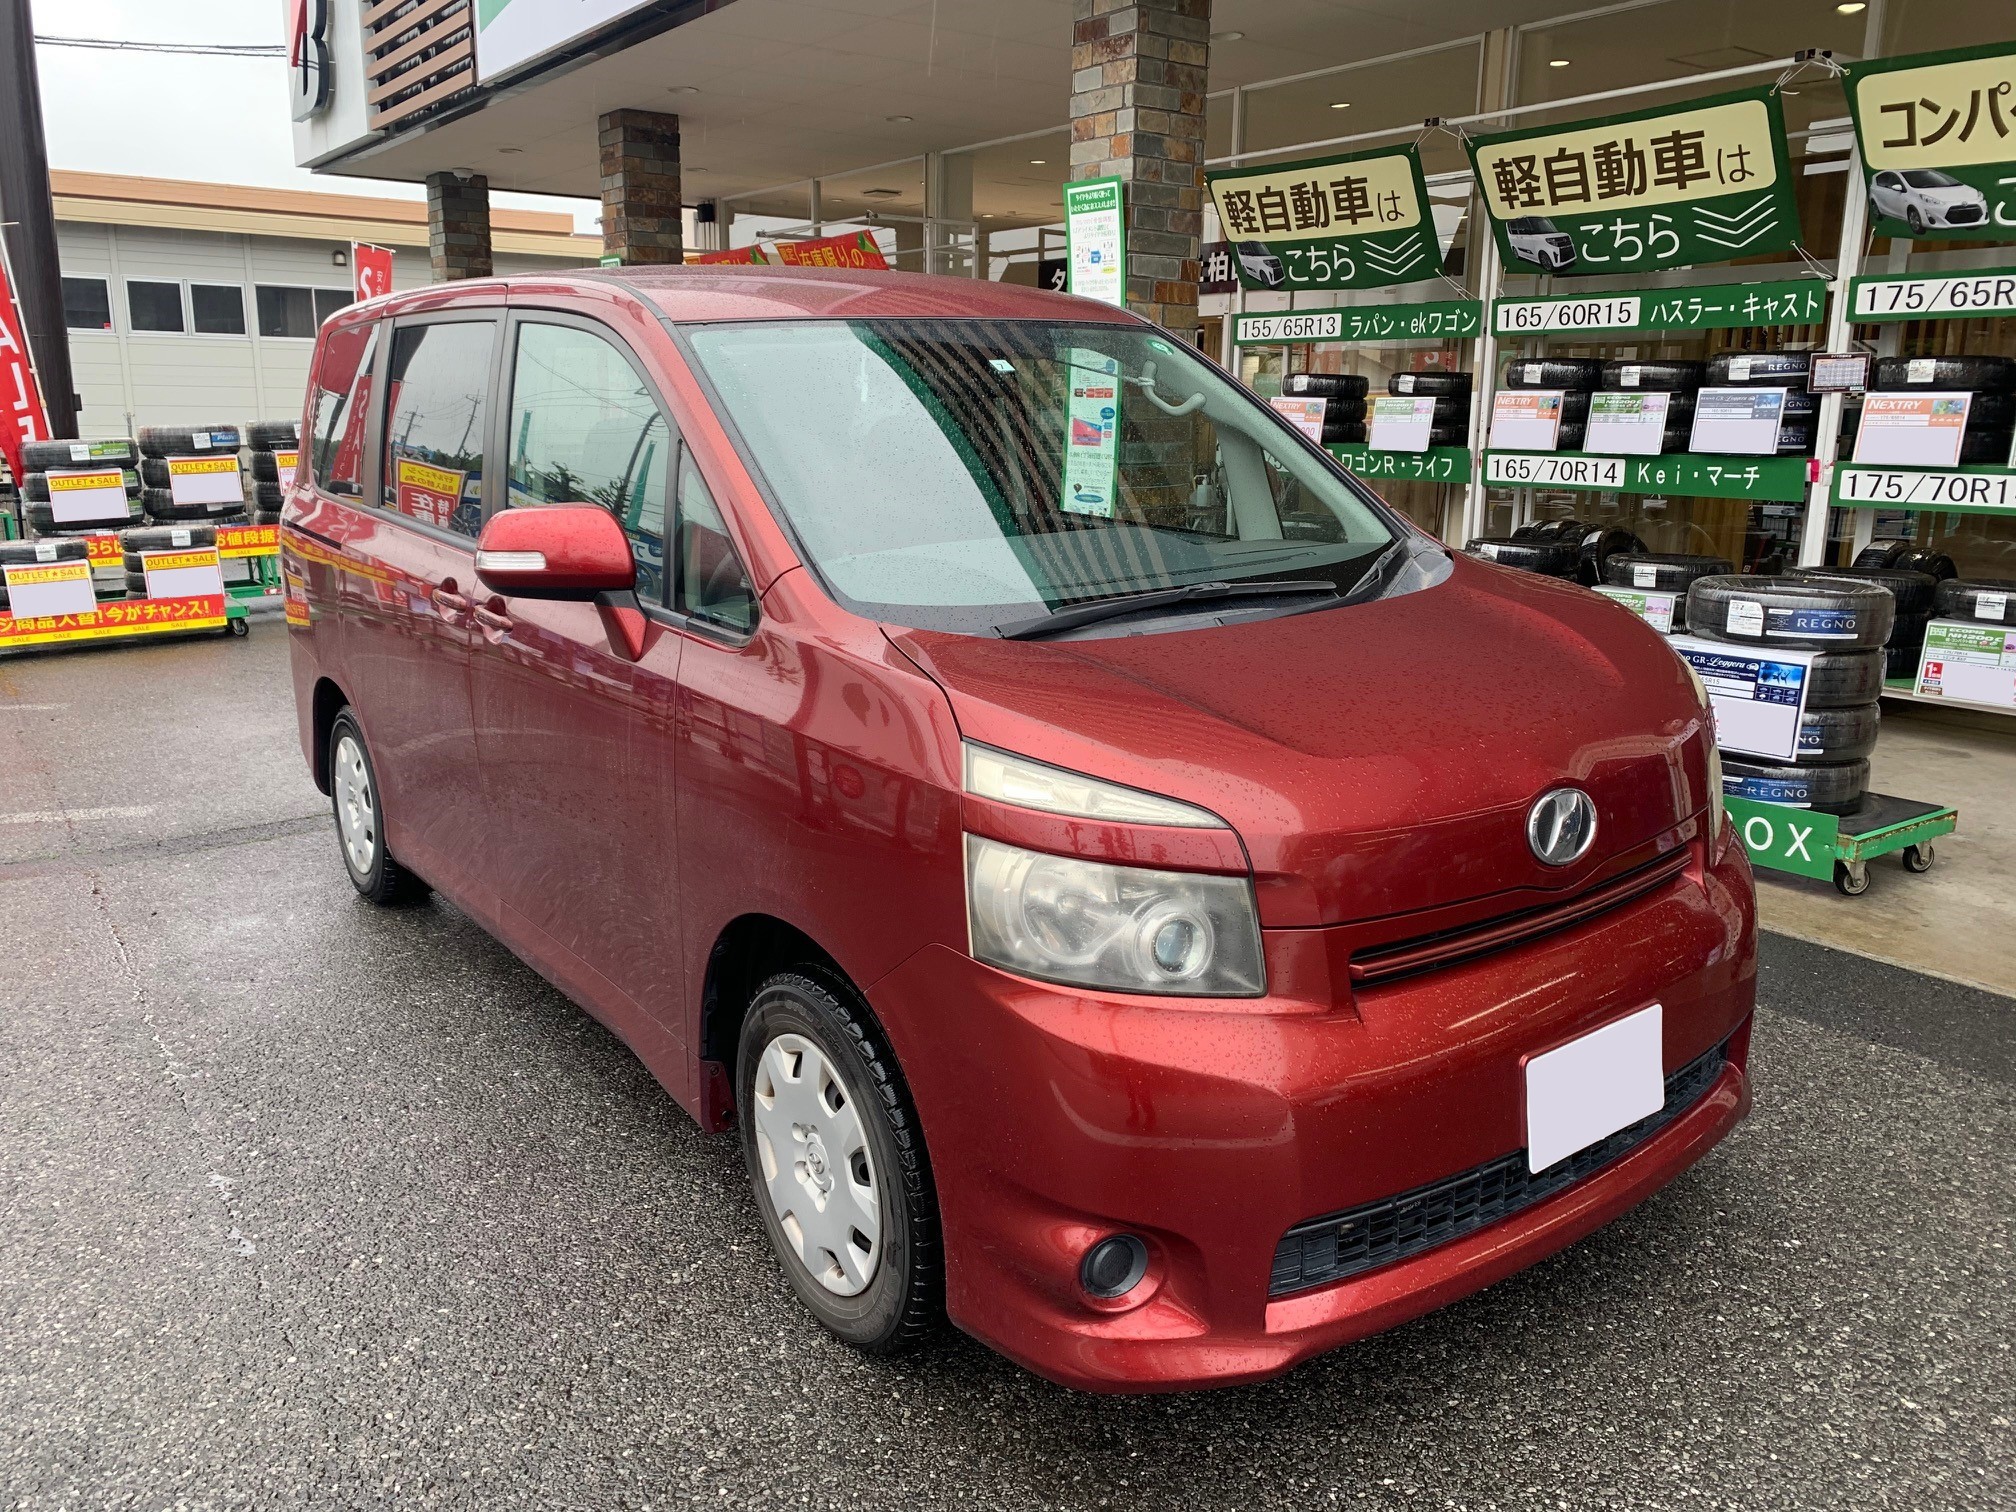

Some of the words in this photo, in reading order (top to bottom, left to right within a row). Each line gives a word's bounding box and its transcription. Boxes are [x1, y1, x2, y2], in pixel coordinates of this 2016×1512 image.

[1880, 80, 2016, 149] コンパ
[1492, 130, 1755, 210] 軽自動車は
[1222, 175, 1405, 234] 軽自動車は
[1579, 214, 1680, 263] こちら
[1286, 243, 1356, 282] こちら
[1502, 302, 1632, 329] 165/60R15
[1650, 290, 1819, 324] ハスラー・キャスト
[1242, 316, 1337, 339] 155/65R13
[1350, 308, 1477, 339] ラパン・ekワゴン
[1768, 363, 1807, 371] REGNO
[1497, 396, 1533, 406] NEXTRY
[1867, 399, 1923, 410] NEXTRY
[171, 462, 206, 472] OUTLET
[211, 461, 236, 469] SALE
[278, 456, 299, 464] OUT
[1341, 451, 1453, 478] ワゴンR・ライフ
[1493, 458, 1618, 484] 165/70R14
[50, 478, 87, 488] OUTLET
[96, 476, 121, 485] SALE
[1848, 473, 2016, 505] 175/70R1
[215, 528, 281, 547] お値段据
[146, 556, 184, 567] OUTLET
[193, 554, 216, 563] SALE
[9, 570, 50, 581] OUTLET
[60, 568, 86, 577] SALE
[12, 636, 31, 644] SALE
[53, 632, 72, 640] SALE
[93, 628, 112, 636] SALE
[171, 621, 188, 629] SALE
[208, 618, 226, 626] SALE
[1797, 618, 1856, 629] REGNO
[1949, 627, 1986, 635] ECOPIA
[1747, 786, 1808, 799] REGNO
